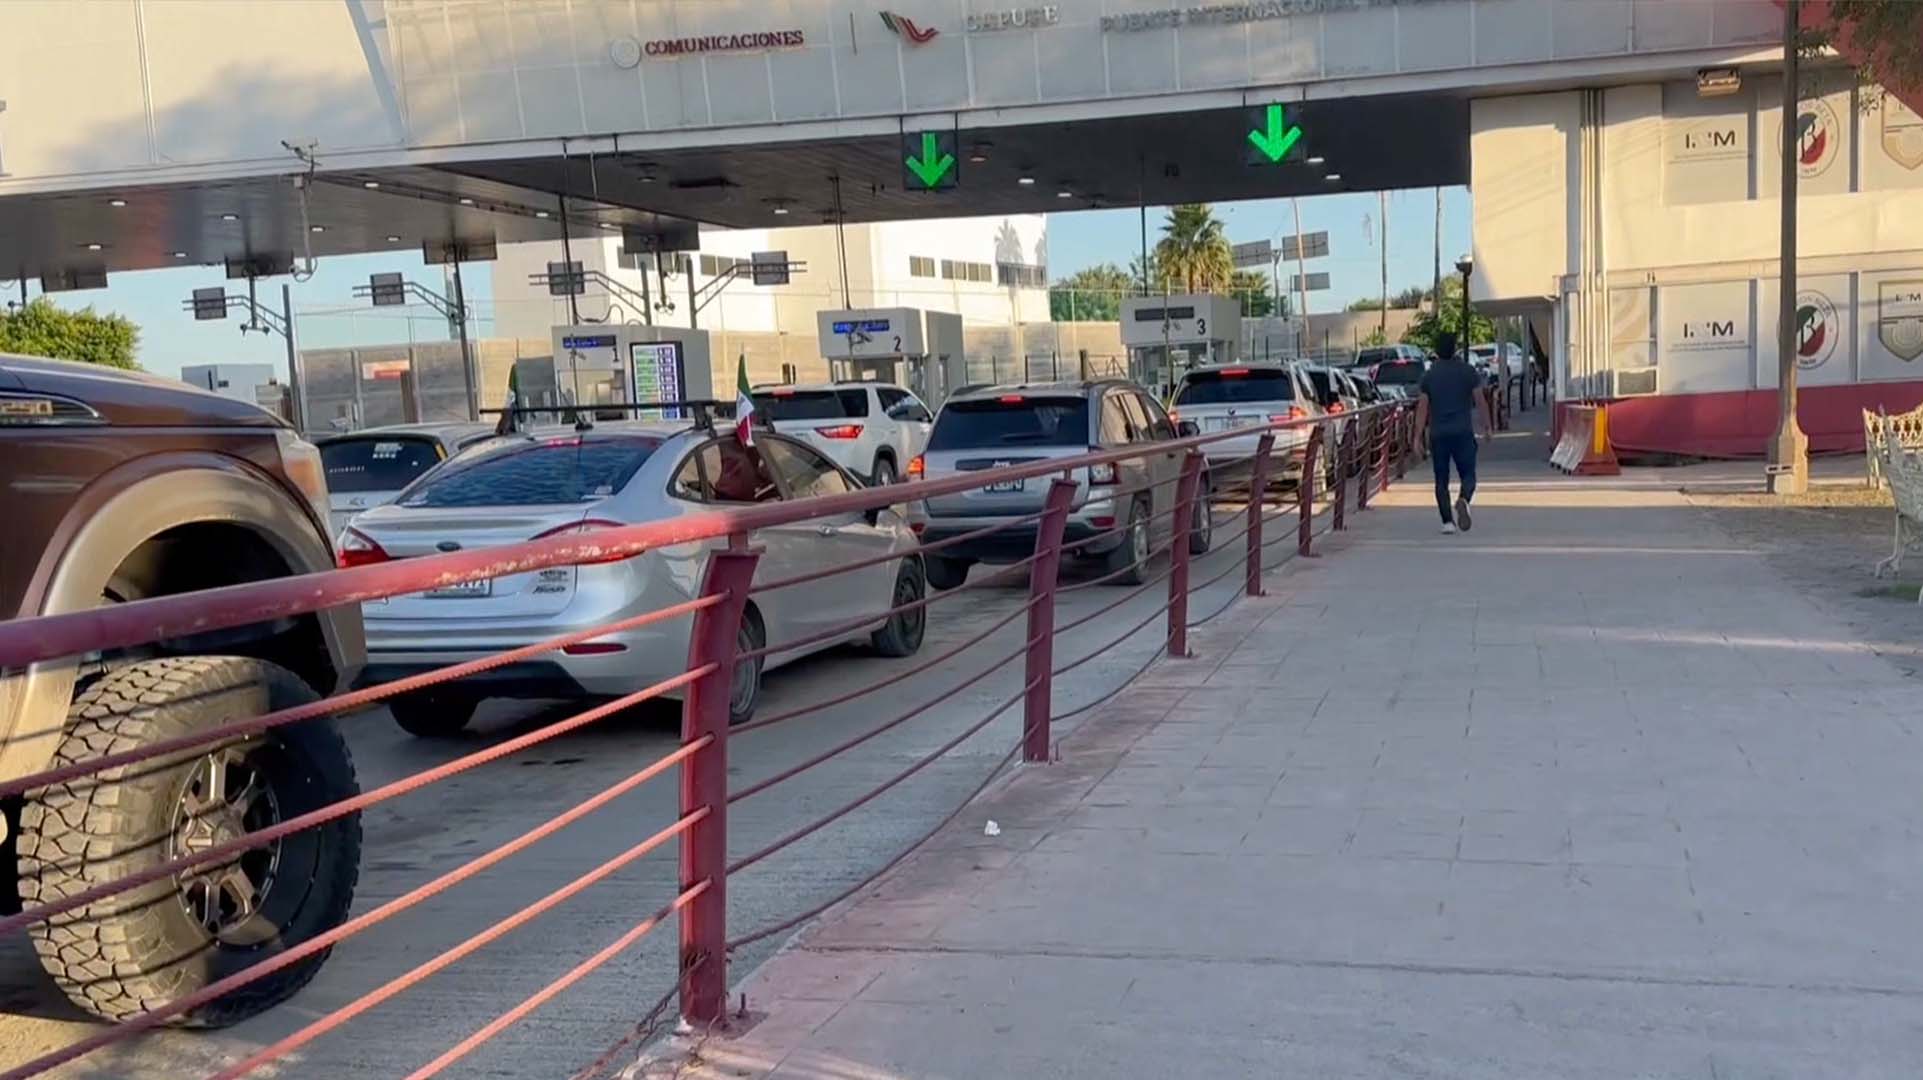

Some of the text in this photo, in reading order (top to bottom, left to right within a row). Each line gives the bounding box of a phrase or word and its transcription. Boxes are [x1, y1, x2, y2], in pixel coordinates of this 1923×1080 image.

[644, 30, 804, 55] COMUNICACIONES
[1197, 318, 1206, 335] 3
[893, 335, 902, 352] 2
[612, 347, 619, 362] 1
